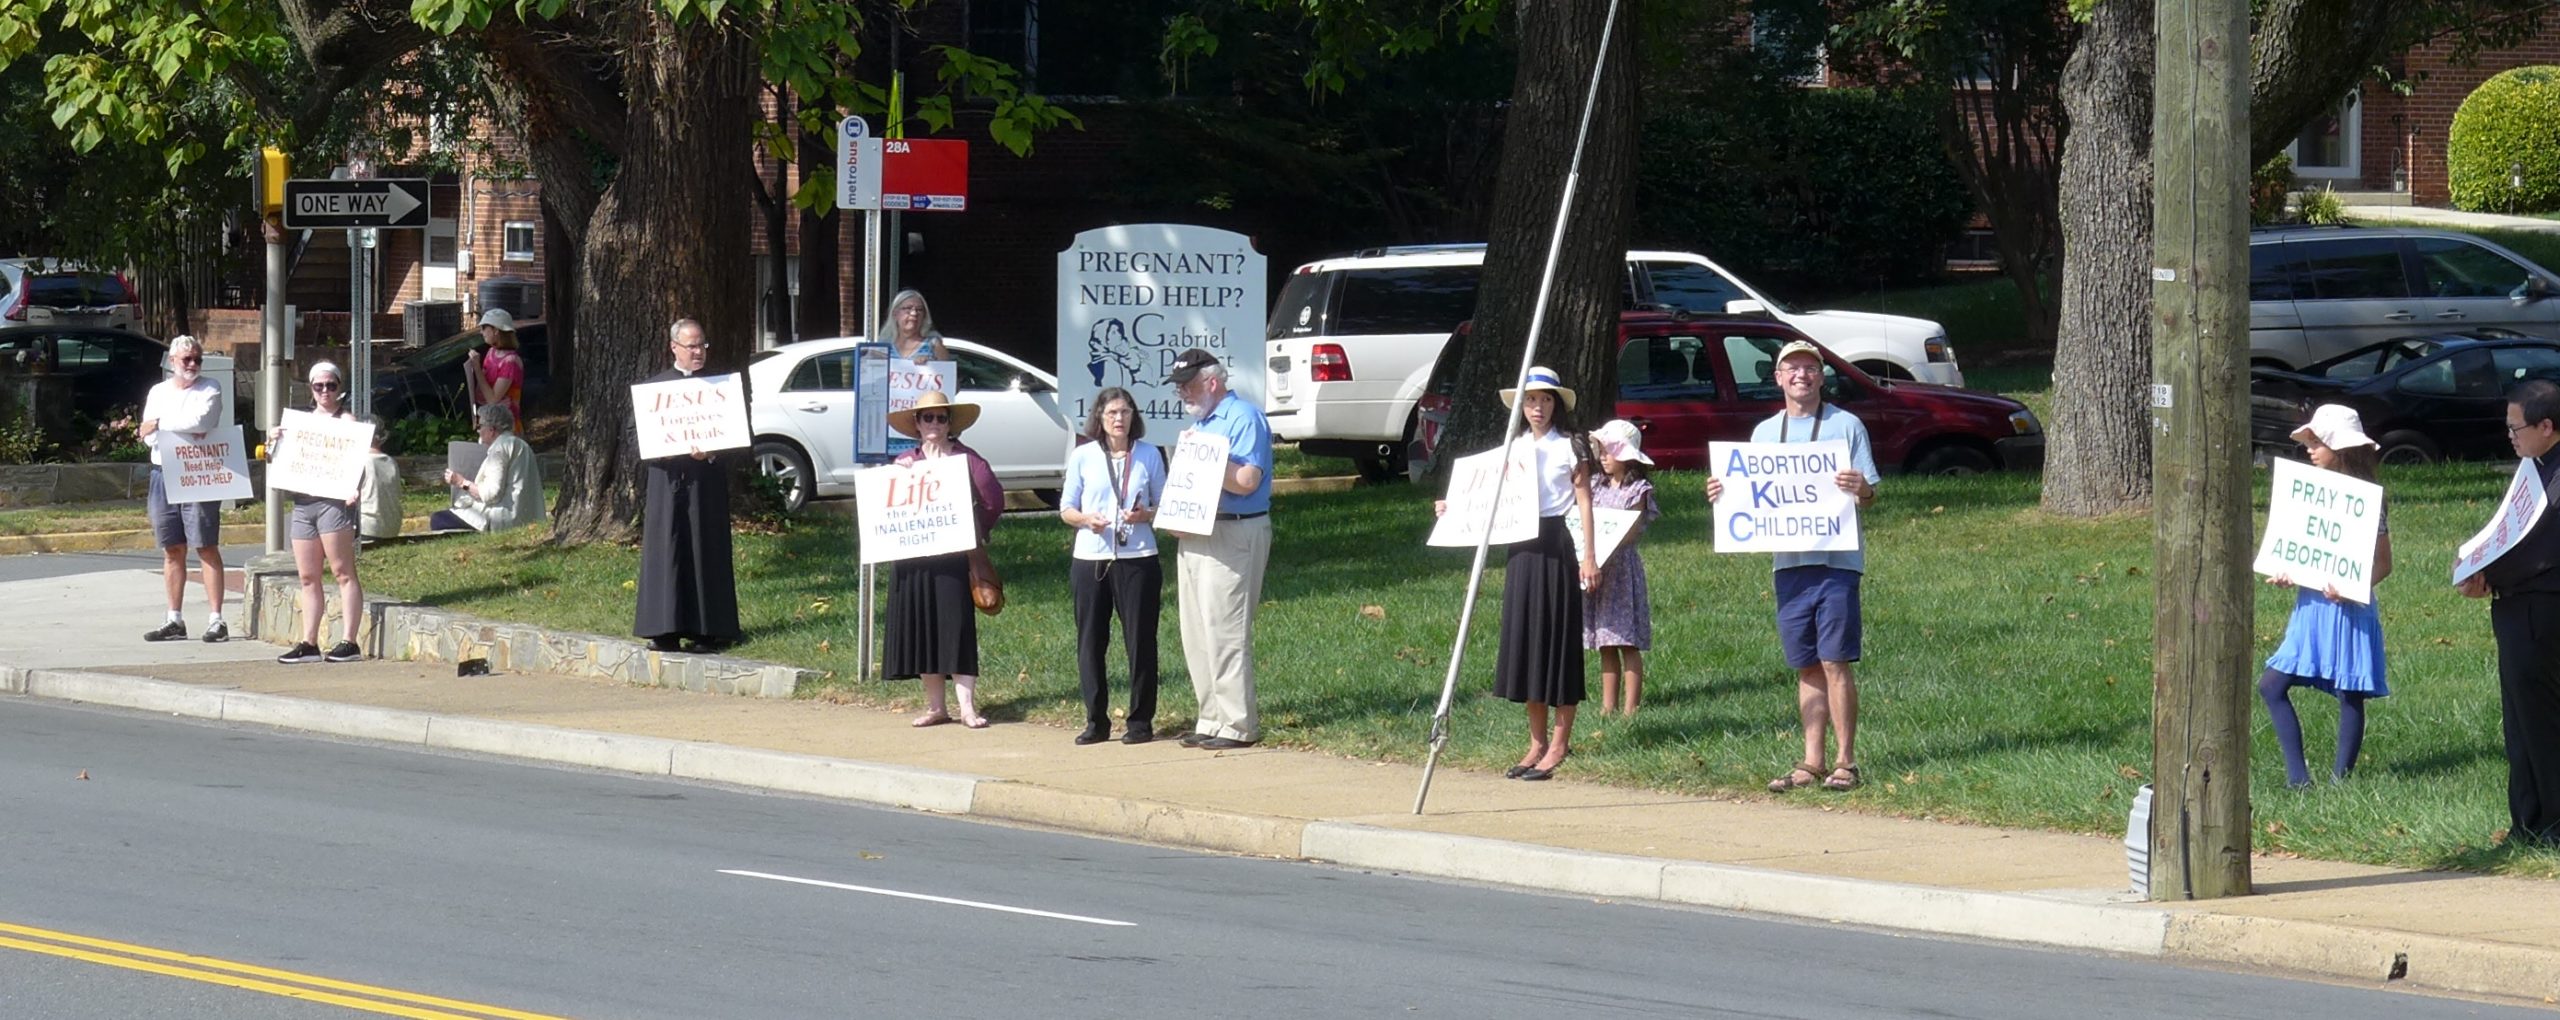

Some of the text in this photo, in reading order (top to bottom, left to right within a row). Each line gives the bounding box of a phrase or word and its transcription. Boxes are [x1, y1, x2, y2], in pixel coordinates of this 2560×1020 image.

[886, 141, 911, 153] 28A
[847, 140, 858, 205] metrobus
[301, 194, 388, 213] ONE WAY
[1078, 251, 1246, 275] PREGNANT?
[1080, 284, 1244, 308] NEED HELP?
[1132, 312, 1227, 349] Gabriel
[889, 371, 944, 391] ESUS
[649, 387, 726, 412] JESUS
[296, 429, 357, 451] PREGNANT?
[682, 427, 725, 441] Heals
[175, 442, 230, 460] PREGNANT?
[184, 458, 225, 473] Need Help?
[179, 472, 233, 487] 800-712-HELP
[885, 470, 941, 516] Life
[1751, 481, 1818, 508] KILLS
[2291, 478, 2365, 518] PRAY TO
[886, 502, 953, 519] the first
[875, 513, 958, 536] INALIENABLE
[1728, 512, 1841, 542] CHILDREN
[2306, 514, 2342, 543] END
[899, 531, 937, 547] RIGHT
[2271, 537, 2362, 582] ABORTION
